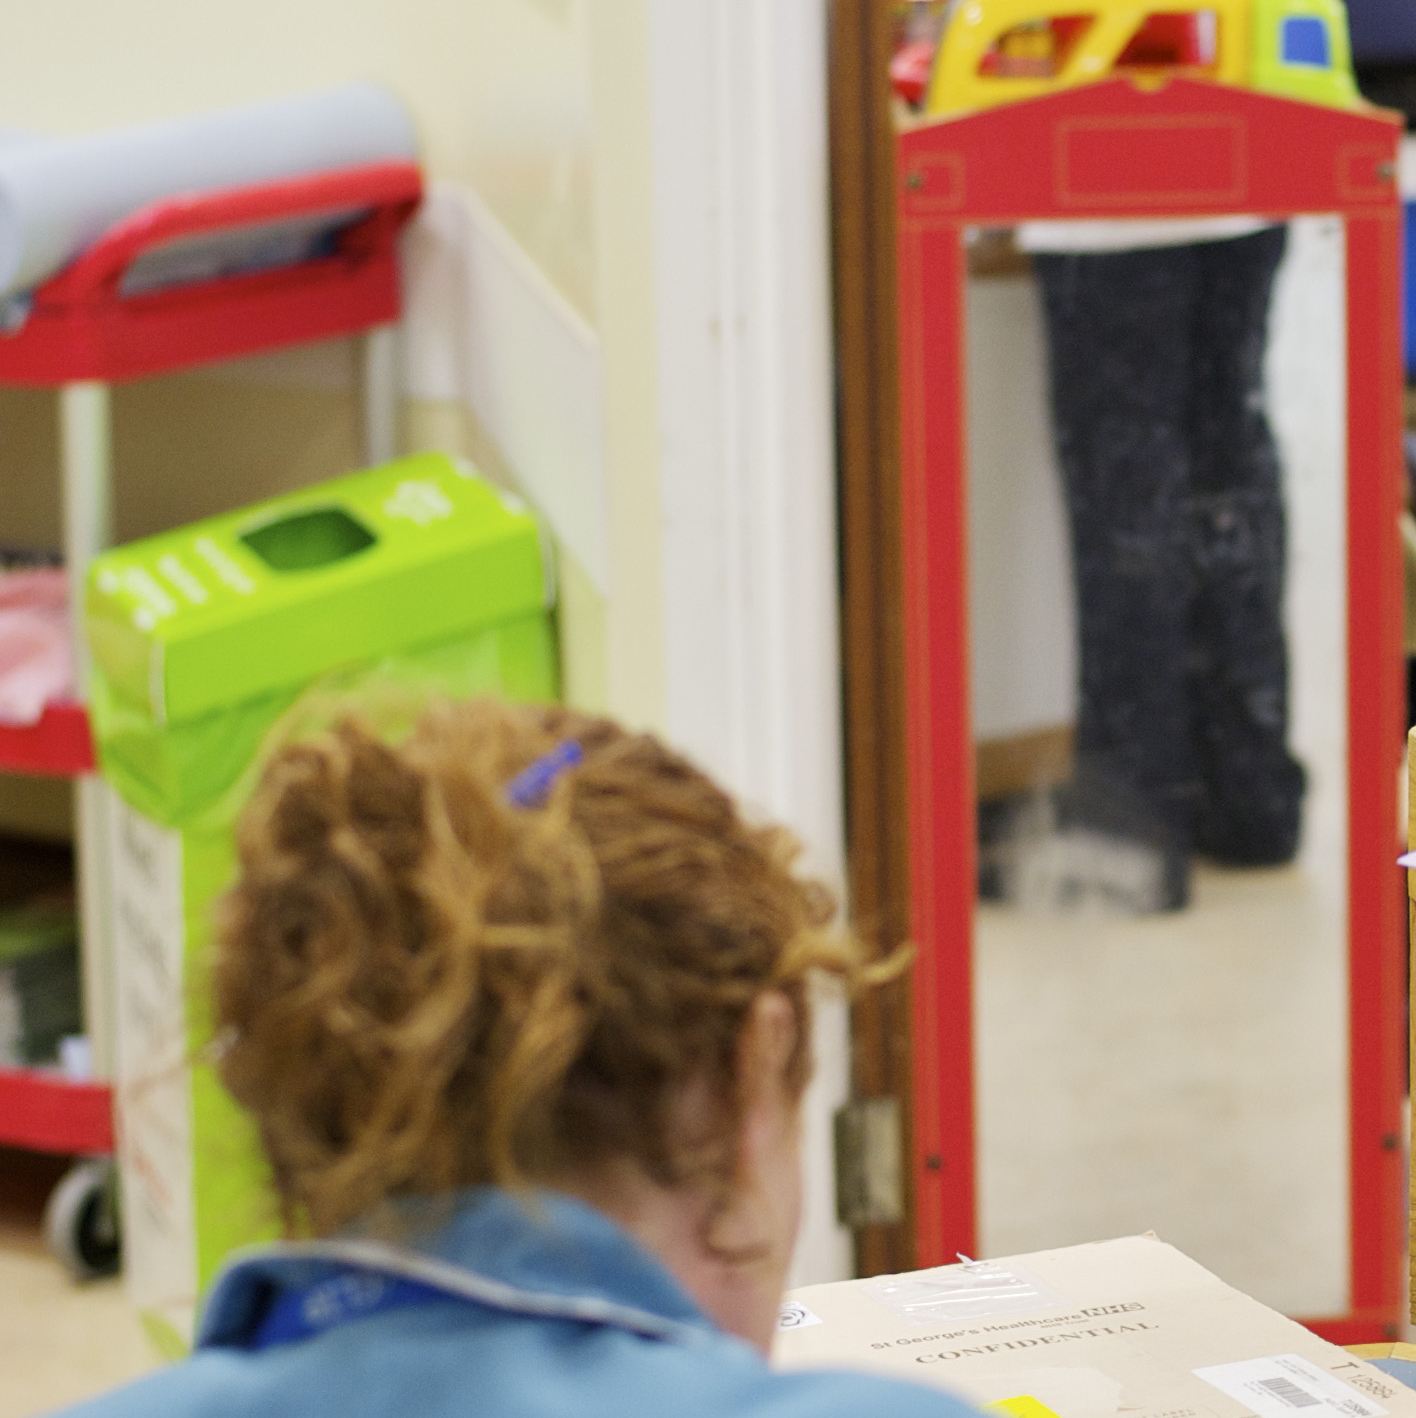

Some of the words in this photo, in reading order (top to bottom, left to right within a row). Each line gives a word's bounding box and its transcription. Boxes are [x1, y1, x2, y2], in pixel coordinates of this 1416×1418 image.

[870, 1340, 890, 1351] St
[896, 1328, 981, 1346] George's
[984, 1313, 1083, 1333] Healthcare
[1080, 1301, 1146, 1318] NHS
[914, 1322, 1160, 1365] CONFIDENTIAL
